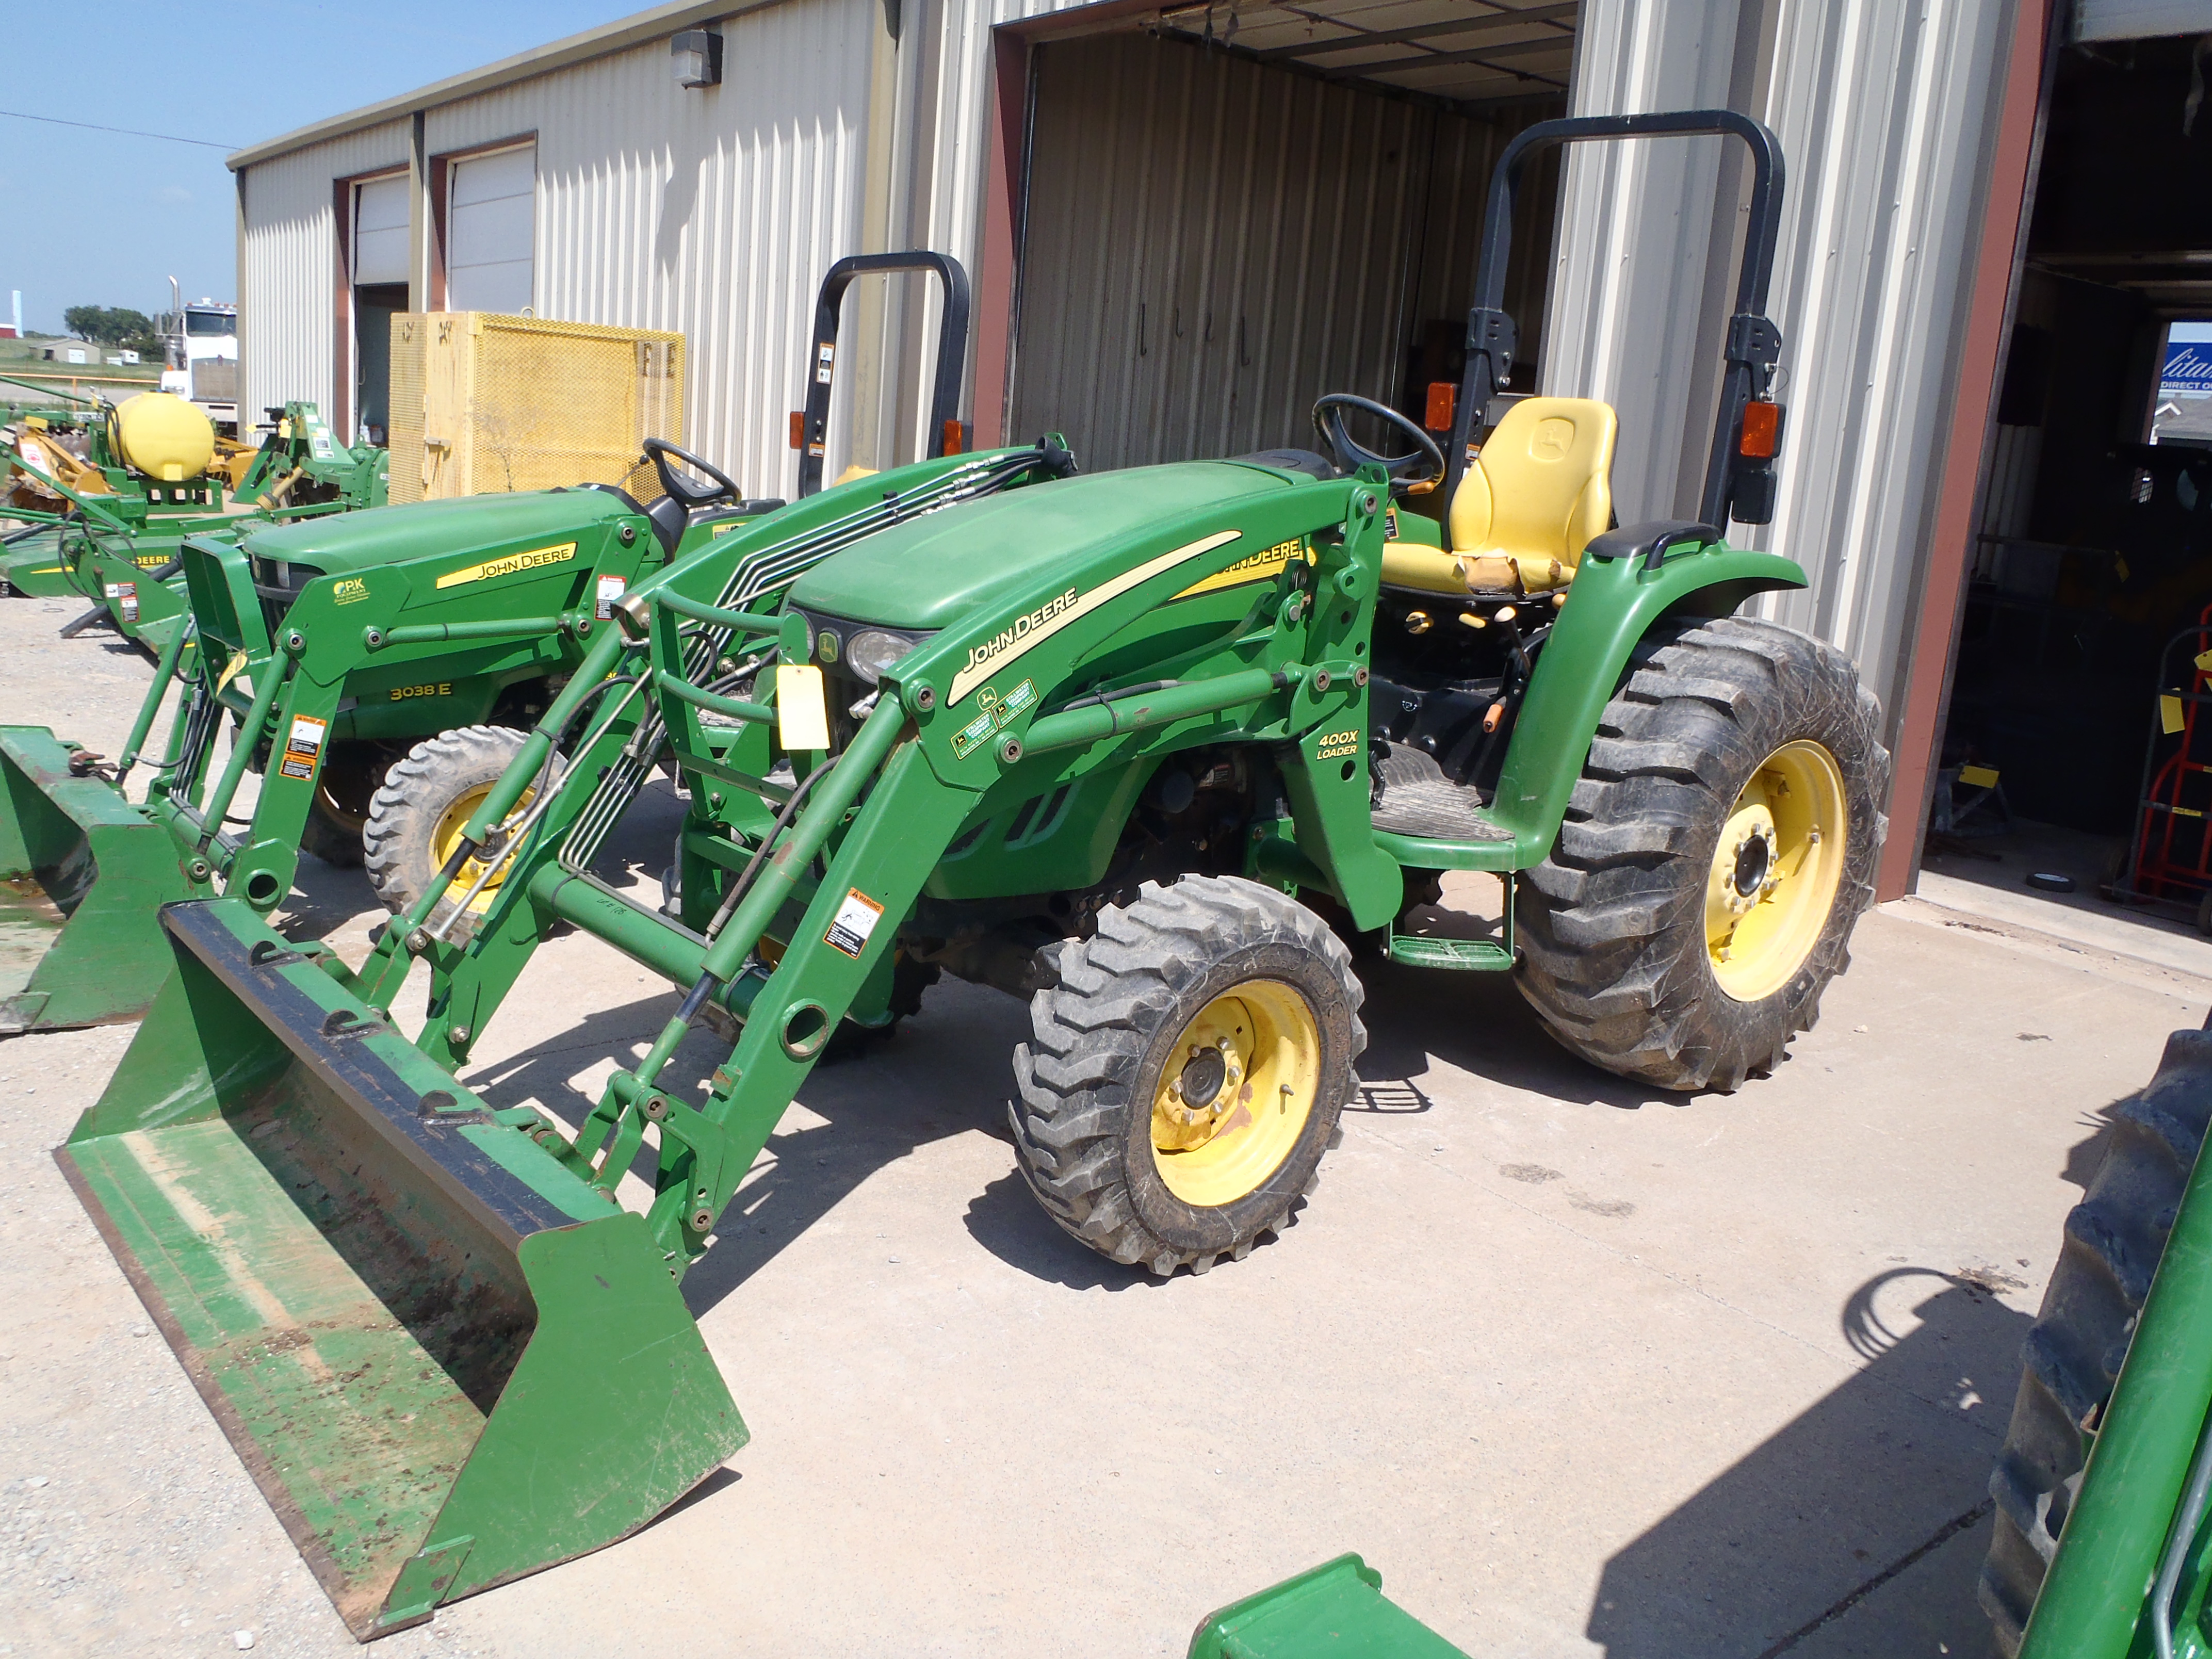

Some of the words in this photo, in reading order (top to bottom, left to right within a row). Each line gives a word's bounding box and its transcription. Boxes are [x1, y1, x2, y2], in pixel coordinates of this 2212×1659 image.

[137, 556, 171, 565] DEERE
[478, 560, 518, 578] JOHN
[521, 549, 570, 568] DEERE
[963, 626, 1015, 674] JOHN
[1014, 586, 1078, 641] DEERE
[391, 684, 435, 701] 3038
[438, 683, 451, 695] E
[1006, 682, 1029, 703] STILLWATER
[1008, 687, 1030, 706] EQUIPMENT
[1011, 691, 1030, 708] COMPANY
[966, 713, 990, 734] STILLWATER
[968, 718, 990, 737] EQUIPMENT
[971, 723, 990, 739] COMPANY
[1318, 729, 1360, 748] 400X
[1316, 745, 1358, 760] LOADER
[859, 894, 881, 912] WARNING
